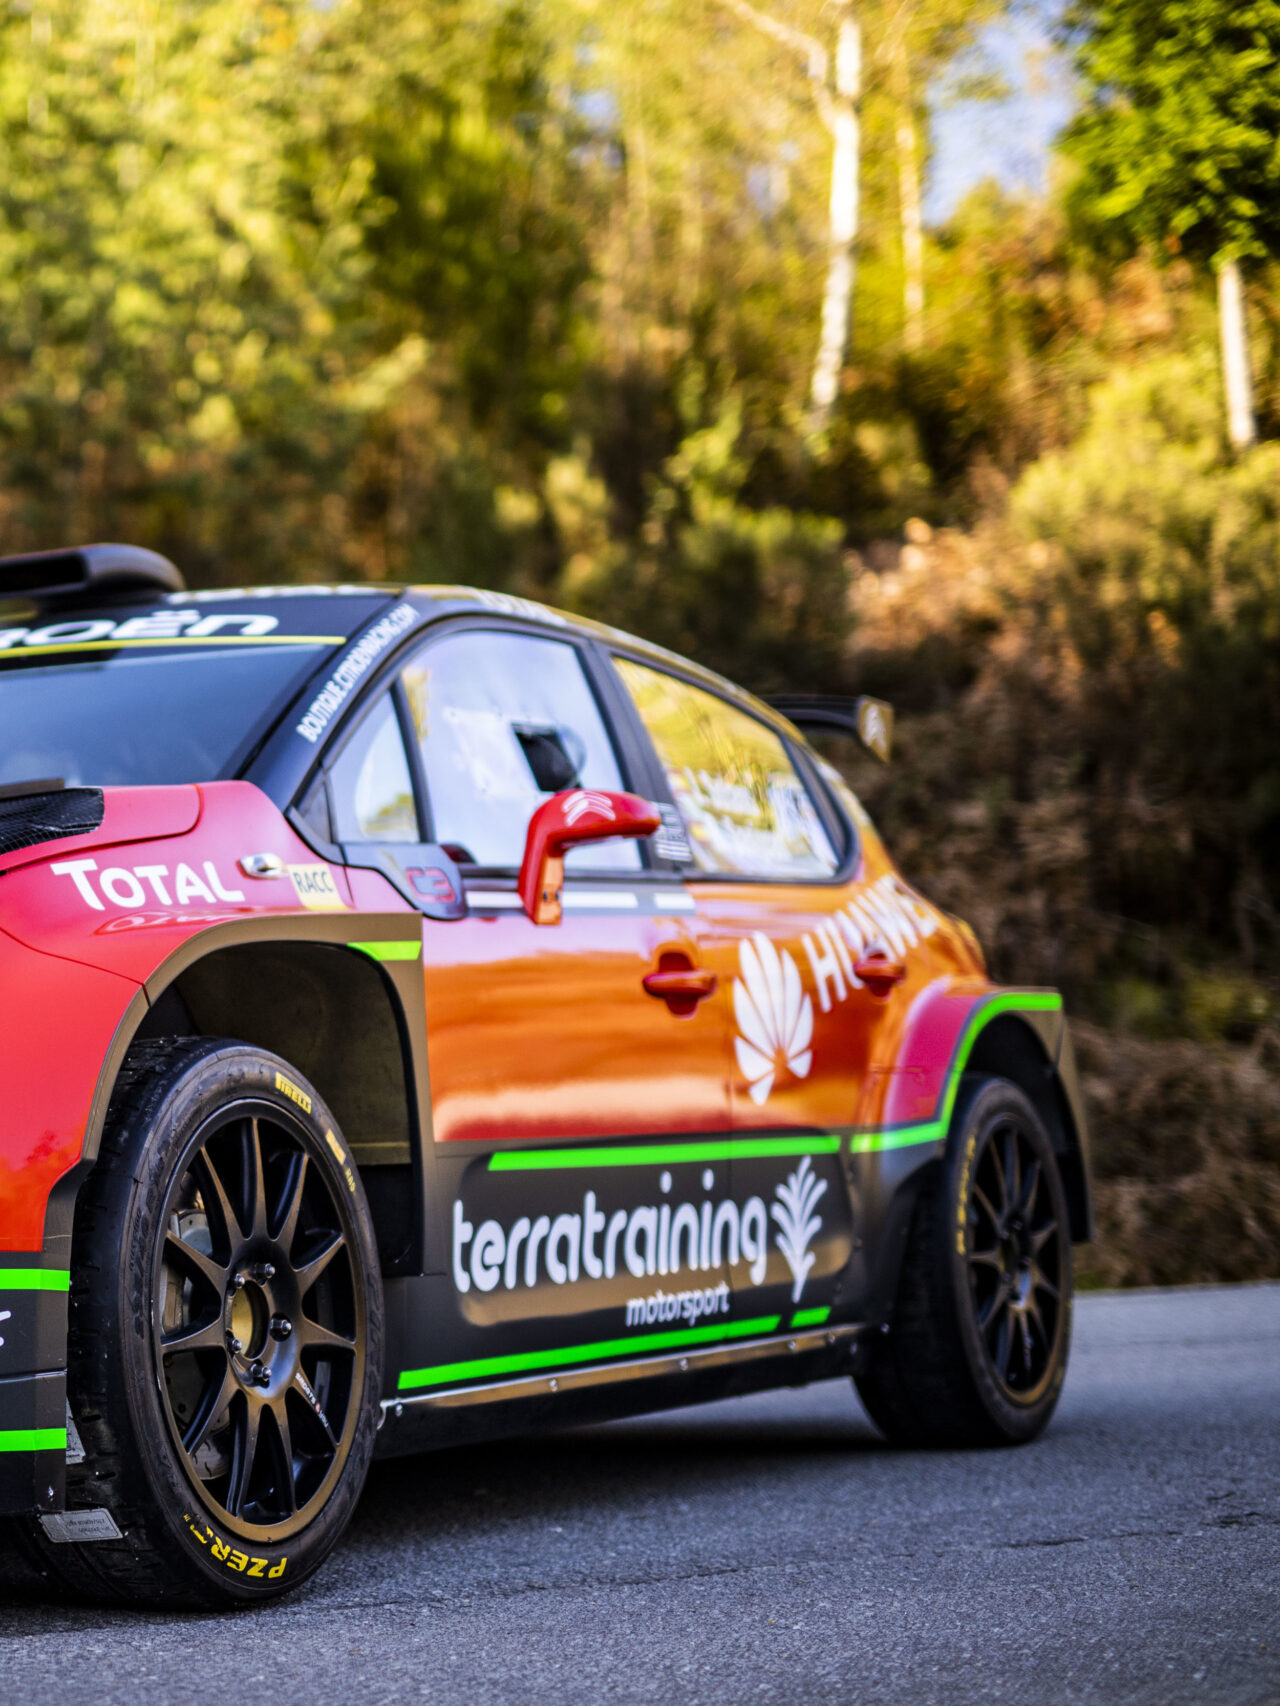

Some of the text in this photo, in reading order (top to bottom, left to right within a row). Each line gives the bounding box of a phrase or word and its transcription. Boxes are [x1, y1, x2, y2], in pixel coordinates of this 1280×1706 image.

[50, 858, 246, 912] TOTAL
[293, 870, 334, 894] RACC
[453, 1168, 767, 1294] terratraining
[626, 1281, 730, 1327] motorsport
